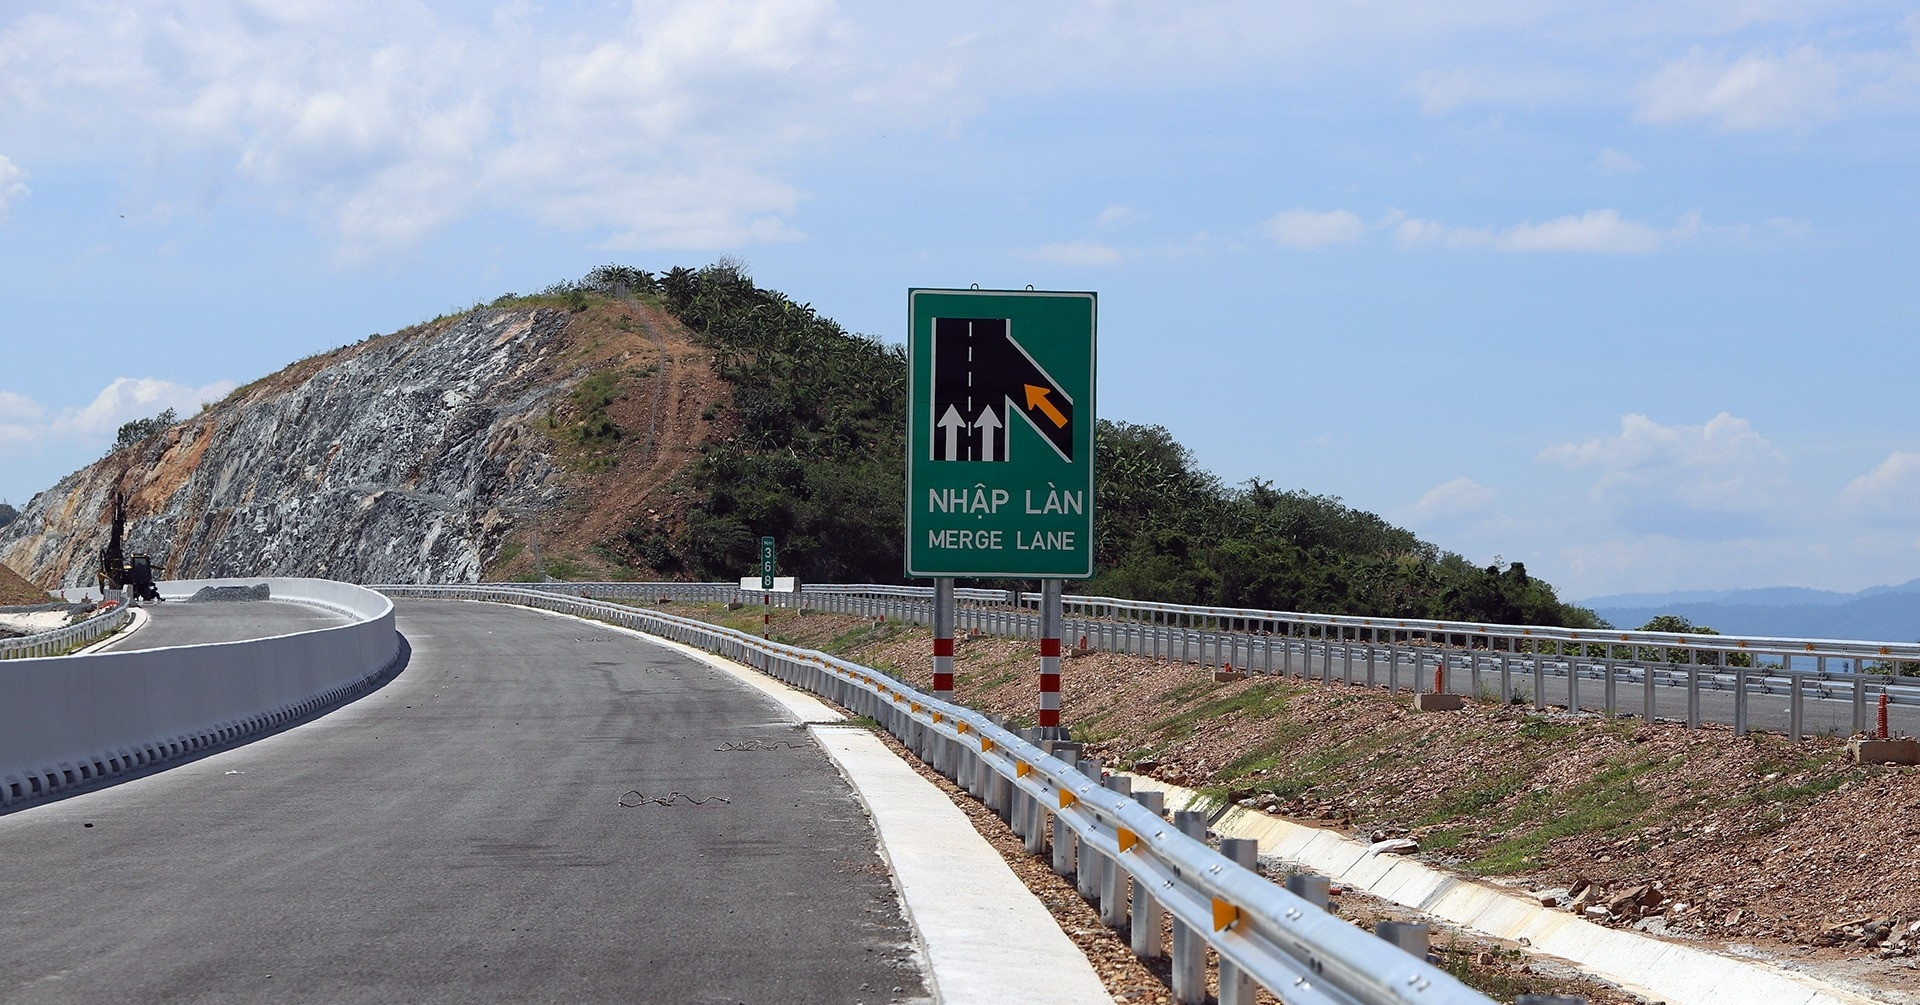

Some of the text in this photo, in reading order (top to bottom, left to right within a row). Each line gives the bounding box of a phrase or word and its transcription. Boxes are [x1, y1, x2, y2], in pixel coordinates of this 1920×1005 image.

[929, 481, 1083, 520] NHẬP LÀN
[928, 529, 1075, 551] MERGE LANE
[764, 547, 772, 586] 368
